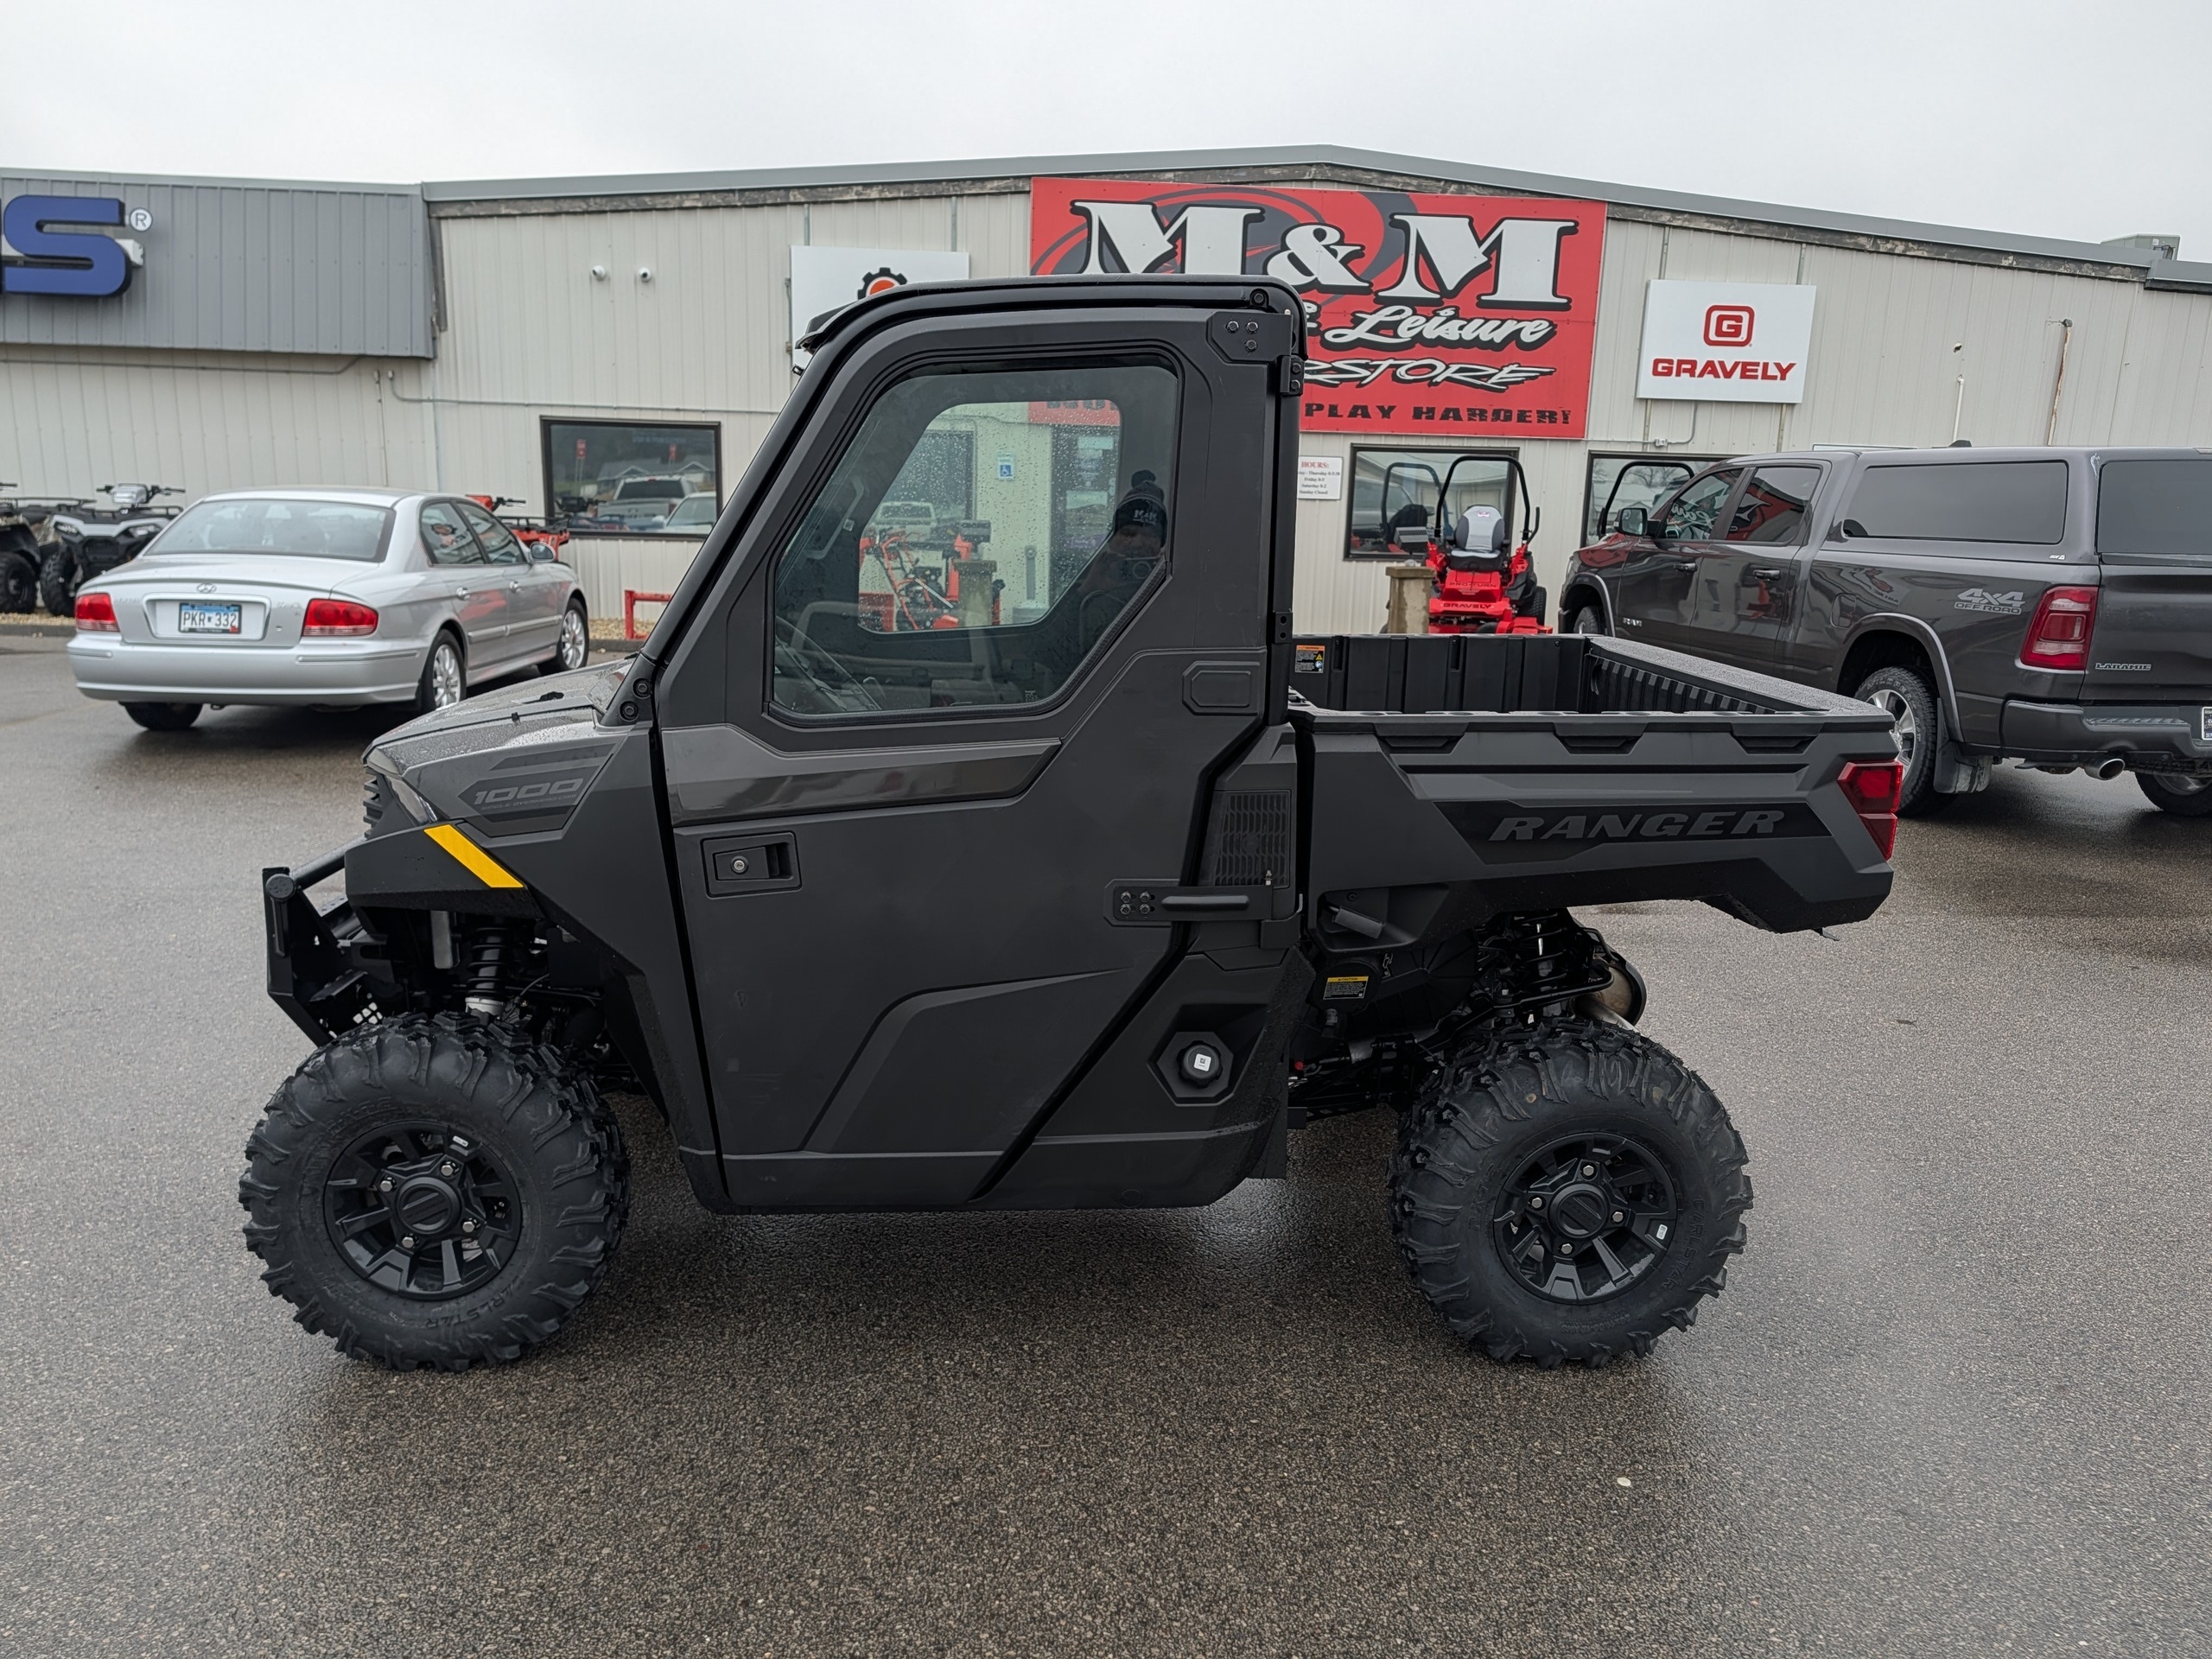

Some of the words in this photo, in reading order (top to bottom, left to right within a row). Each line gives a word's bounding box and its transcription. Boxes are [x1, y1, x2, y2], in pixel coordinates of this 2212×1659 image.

[1323, 305, 1554, 344] Leisure
[1652, 358, 1797, 381] GRAVELY
[1305, 403, 1396, 420] PLAY
[1412, 406, 1572, 424] HARDER!
[183, 611, 206, 626] PKR
[214, 612, 237, 627] 332
[1982, 605, 2021, 614] ROAD
[2095, 662, 2152, 671] LARAMIE
[474, 779, 584, 805] 1000
[512, 797, 557, 807] OVERHEAD
[1488, 810, 1785, 842] RANGER
